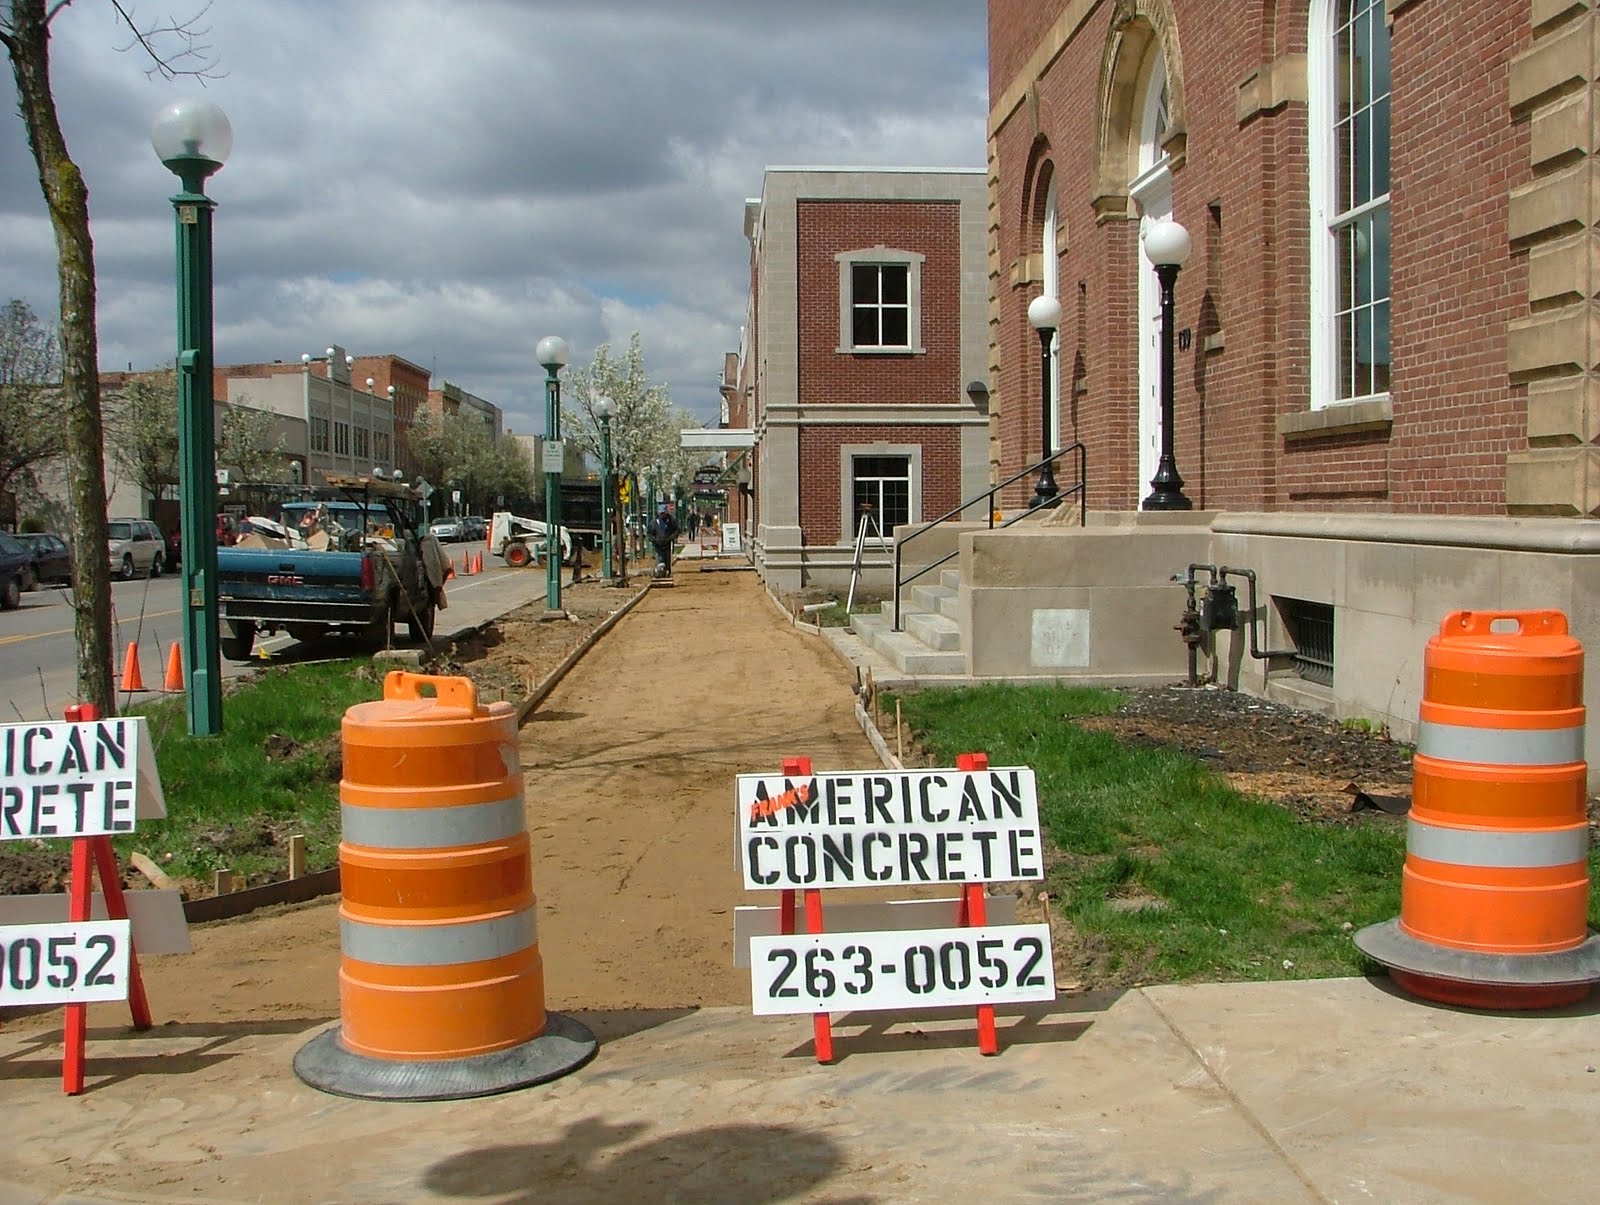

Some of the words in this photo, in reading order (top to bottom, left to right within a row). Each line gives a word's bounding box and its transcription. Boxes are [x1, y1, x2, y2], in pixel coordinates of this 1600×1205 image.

[267, 575, 305, 586] GMC
[5, 721, 126, 777] ICAN
[749, 772, 1022, 828] AMERICAN
[748, 829, 1038, 885] CONCRETE
[767, 936, 1045, 998] 263-0052
